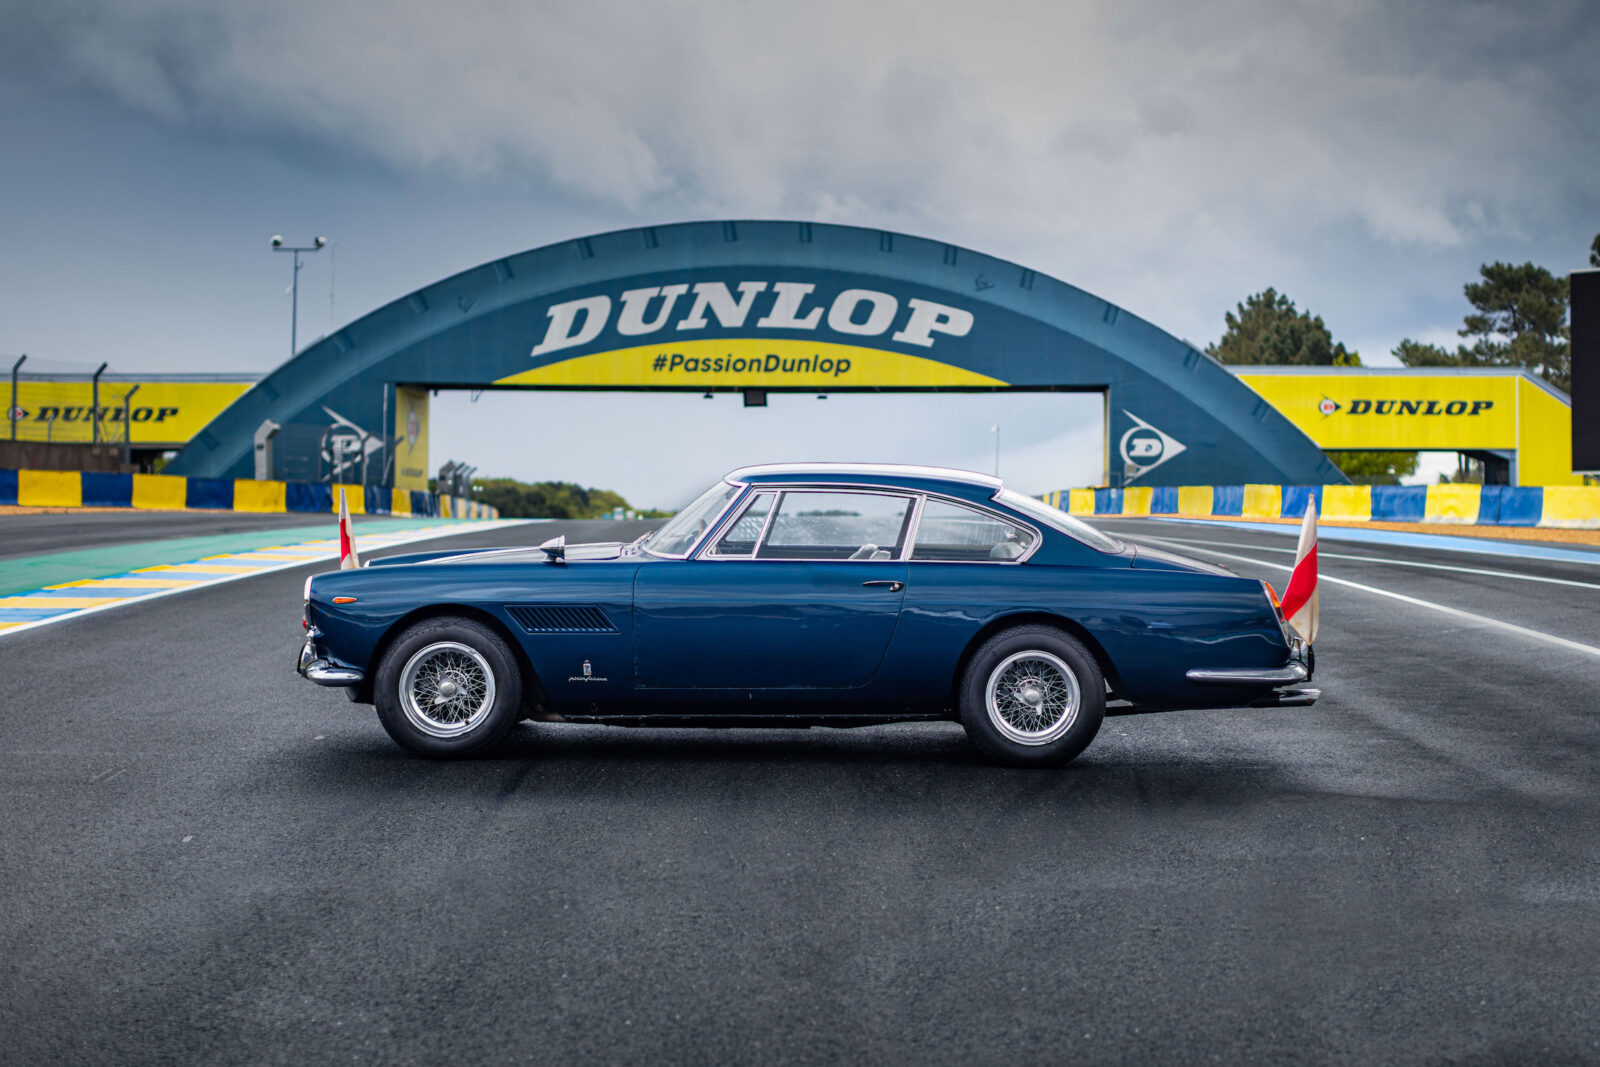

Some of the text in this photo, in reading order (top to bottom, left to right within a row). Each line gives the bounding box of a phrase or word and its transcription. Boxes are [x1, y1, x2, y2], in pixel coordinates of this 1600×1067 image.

[531, 281, 975, 357] DUNLOP
[652, 354, 851, 377] #PassionDunlop
[34, 406, 178, 422] DUNLOP
[1346, 400, 1494, 415] DUNLOP
